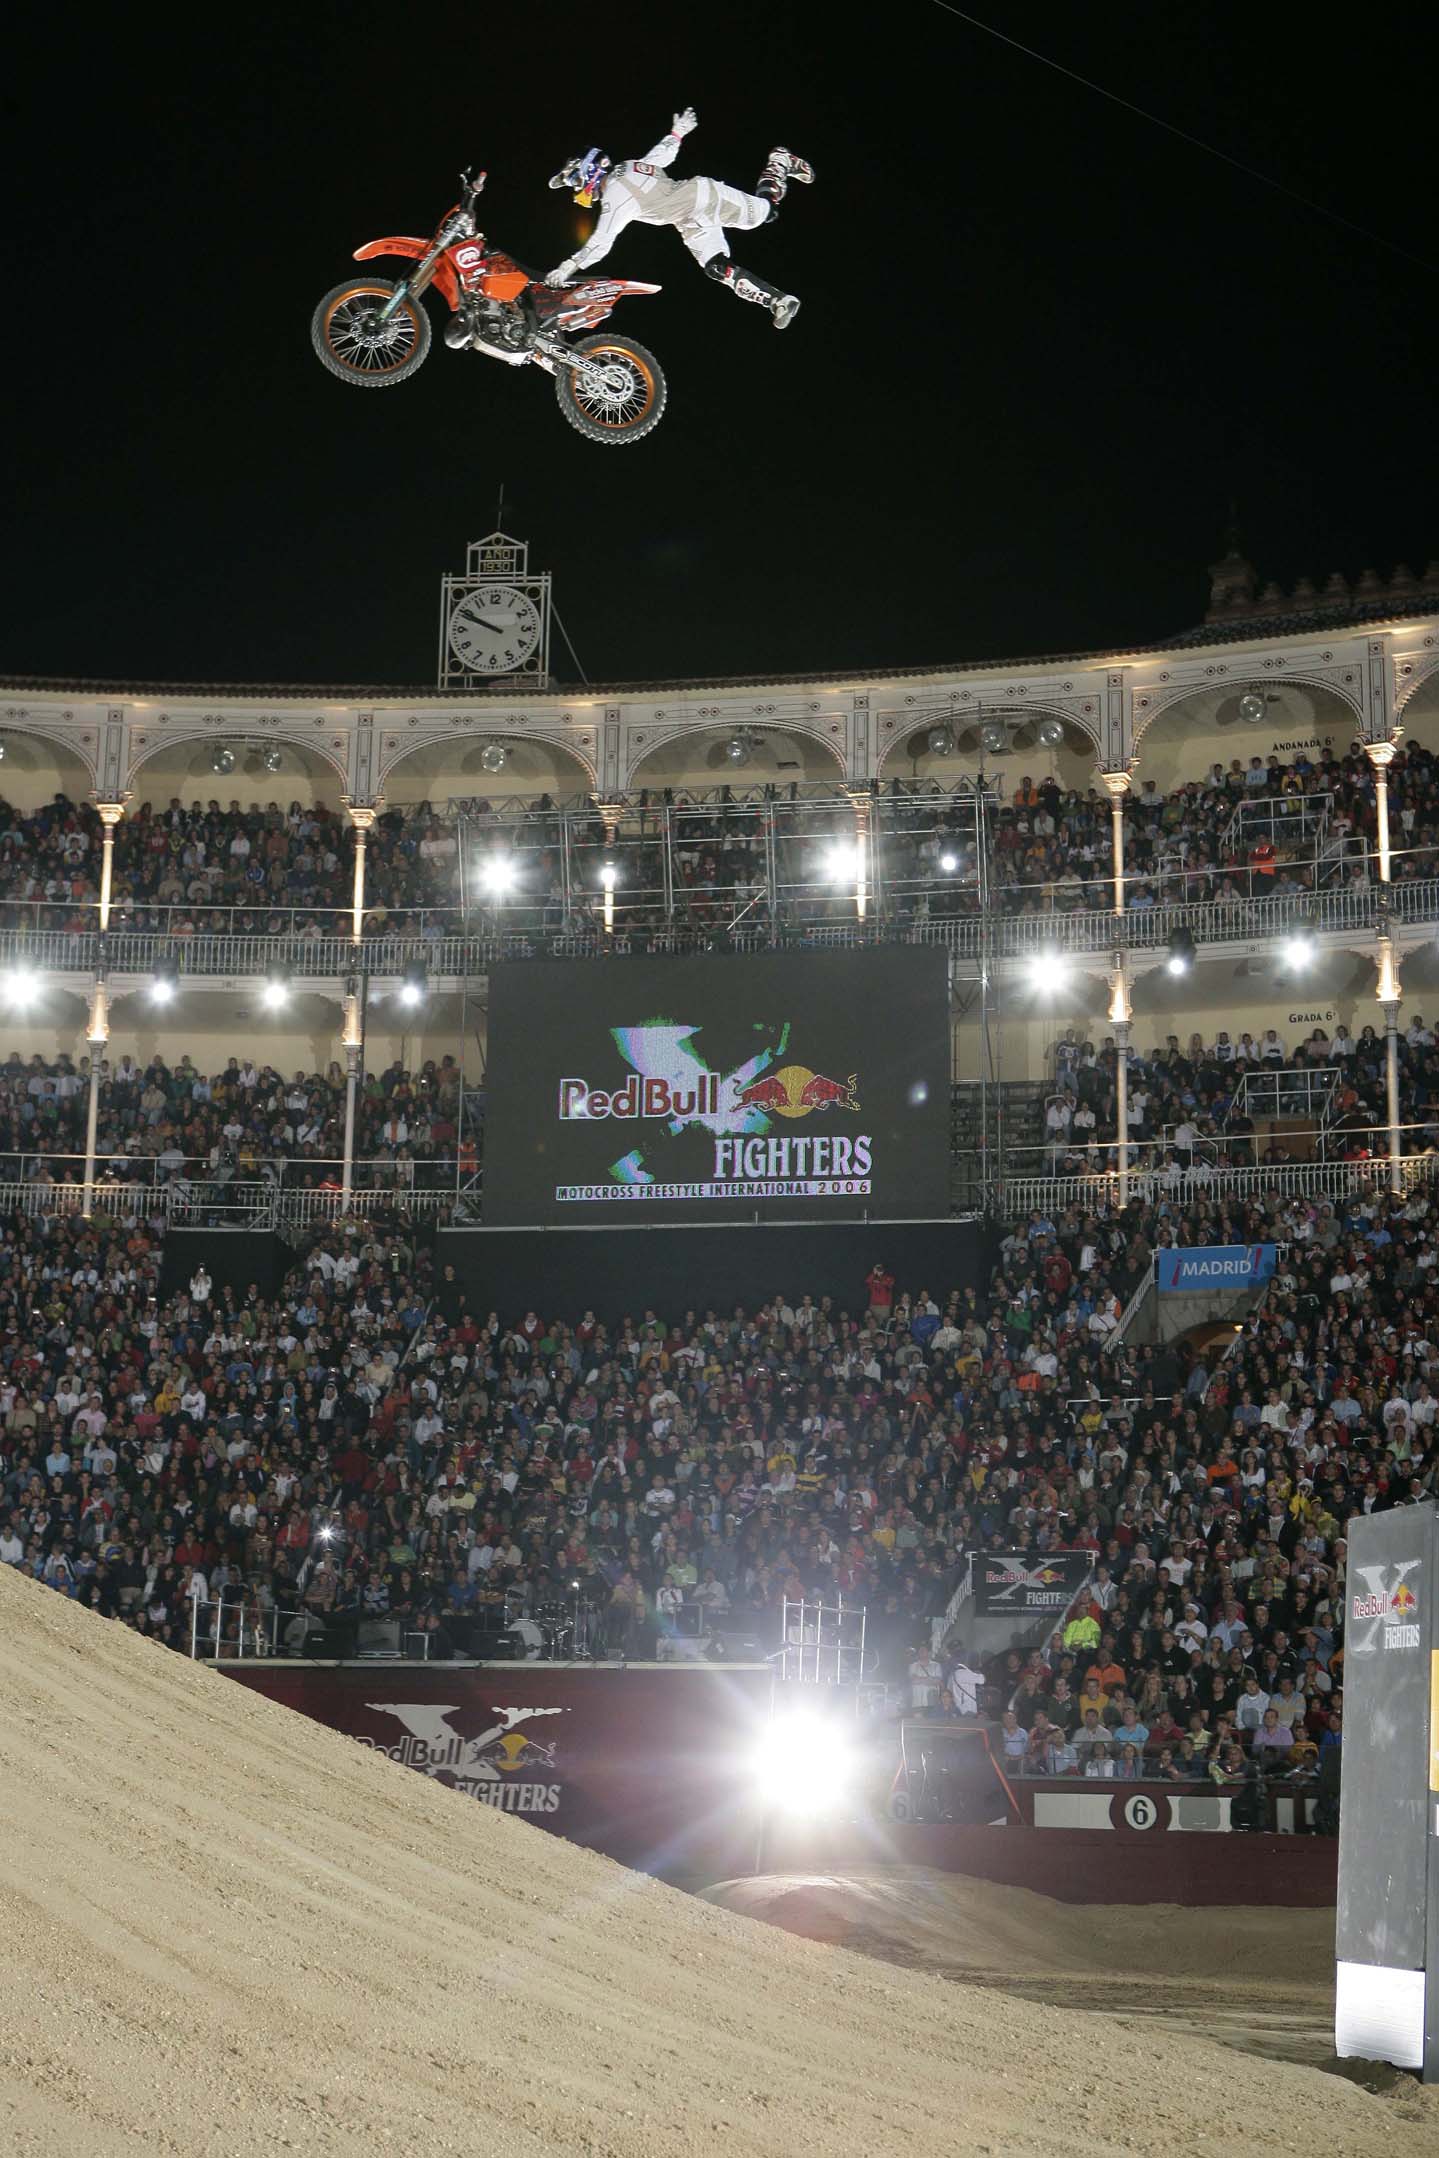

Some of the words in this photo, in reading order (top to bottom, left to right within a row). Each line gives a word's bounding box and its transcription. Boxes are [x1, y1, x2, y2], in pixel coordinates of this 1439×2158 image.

[568, 353, 607, 377] SCOTT
[483, 561, 511, 572] 1930
[1273, 739, 1321, 752] ANDANADA
[1289, 1013, 1322, 1023] GRADA
[713, 1135, 873, 1178] FIGHTERS
[557, 1186, 633, 1200] MOTOCROSS
[638, 1184, 705, 1198] FREESTYLE
[709, 1182, 809, 1196] INTERNATIONAL
[818, 1181, 868, 1194] 2006
[1384, 1624, 1420, 1649] FIGHTERS
[1132, 1799, 1149, 1825] 6
